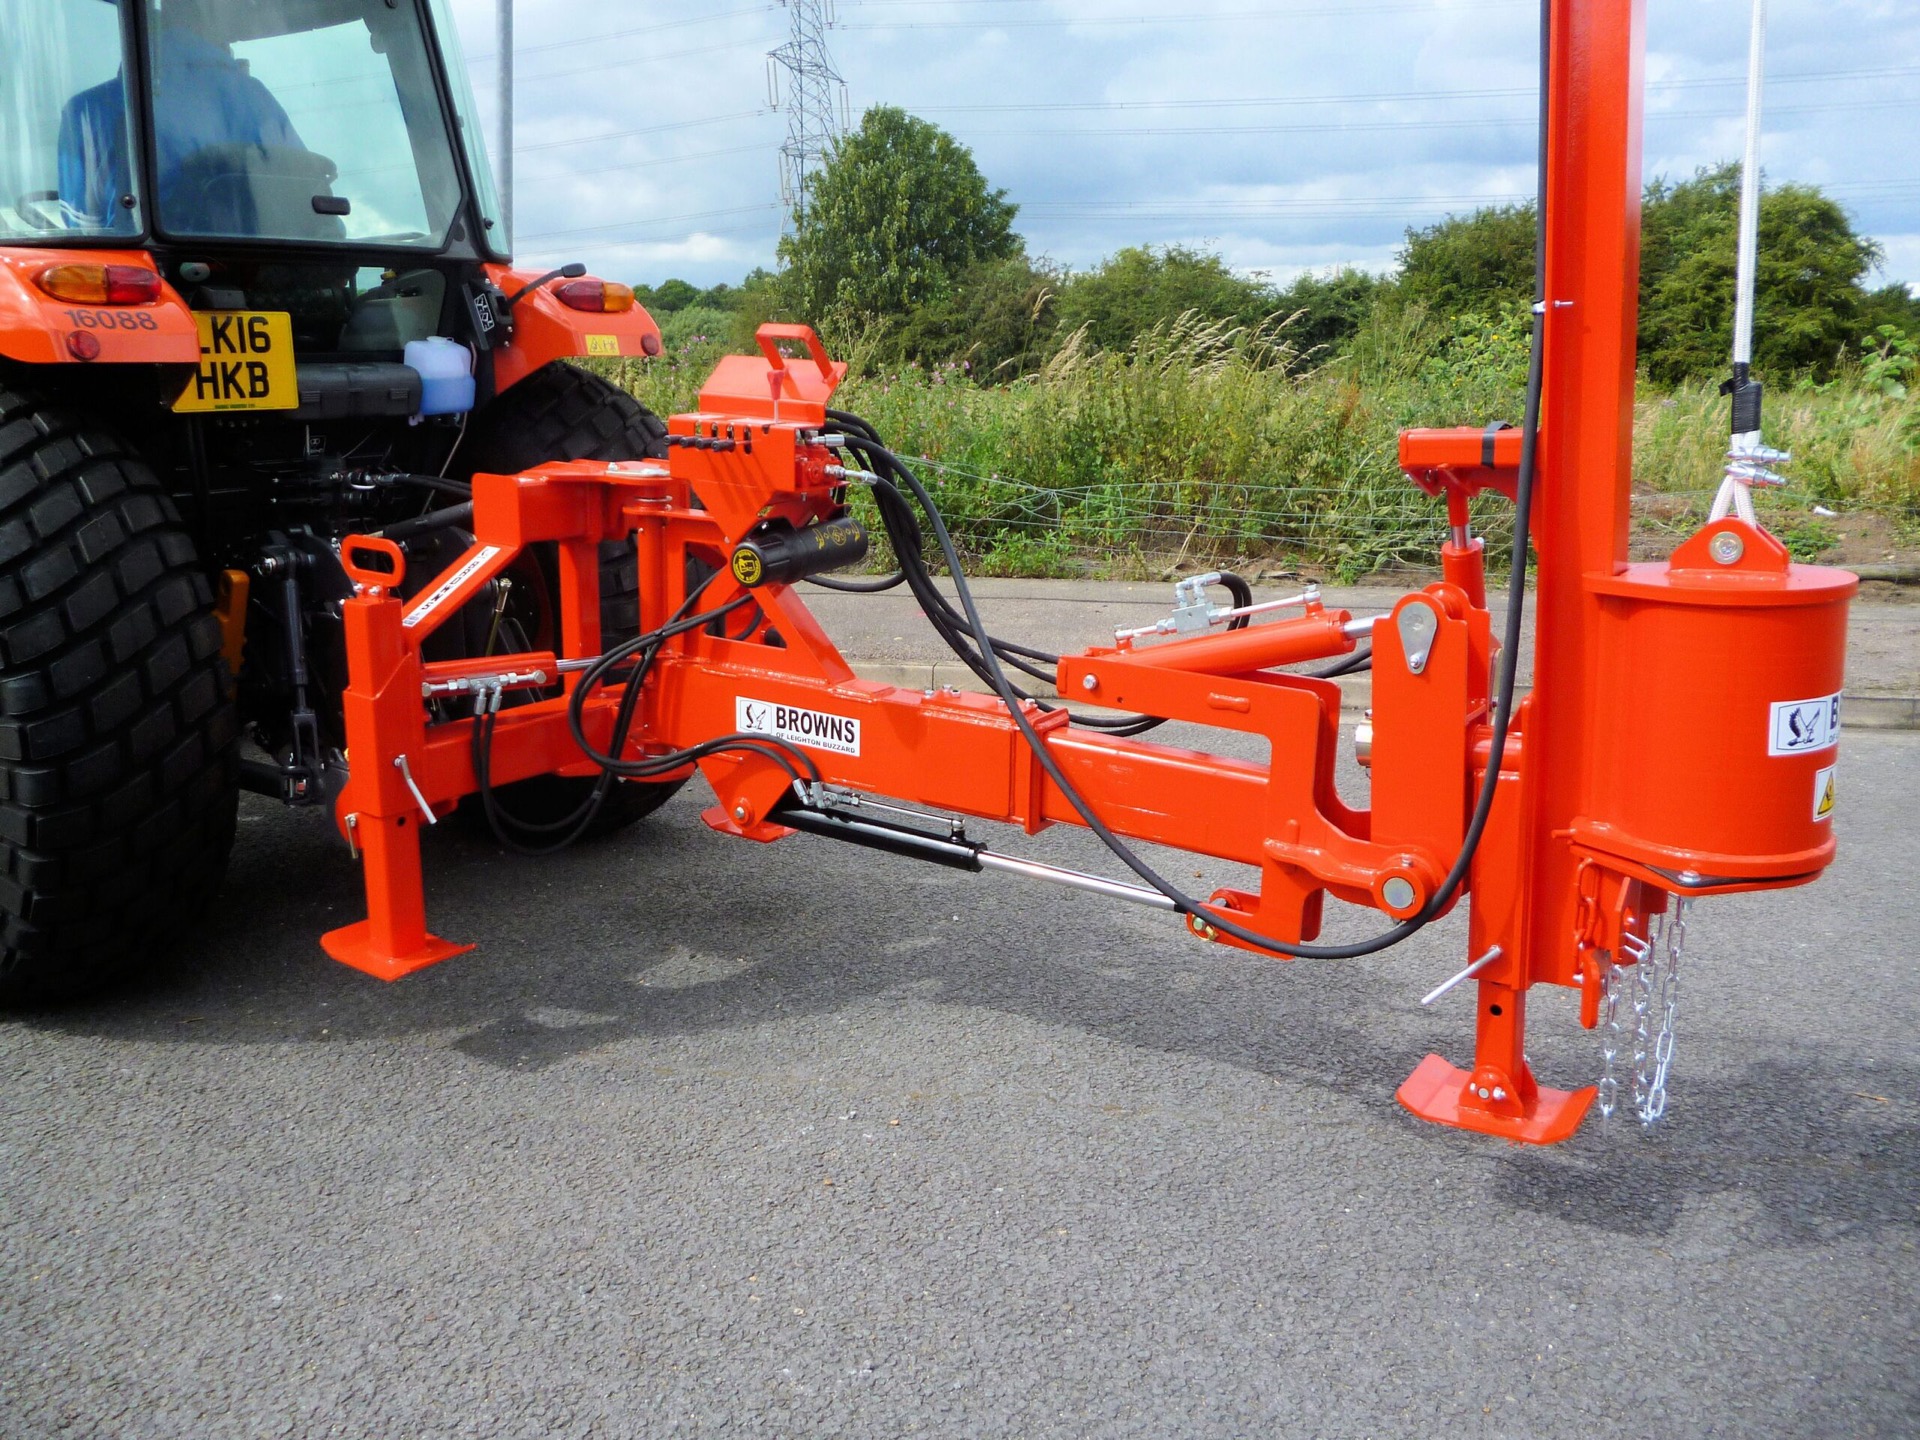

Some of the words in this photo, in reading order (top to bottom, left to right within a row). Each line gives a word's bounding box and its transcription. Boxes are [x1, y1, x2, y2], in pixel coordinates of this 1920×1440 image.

[64, 309, 158, 331] 16088
[196, 361, 270, 400] HKB
[775, 706, 855, 744] BROWNS
[786, 734, 821, 747] LEIGHTON
[822, 741, 856, 754] BUZZARD
